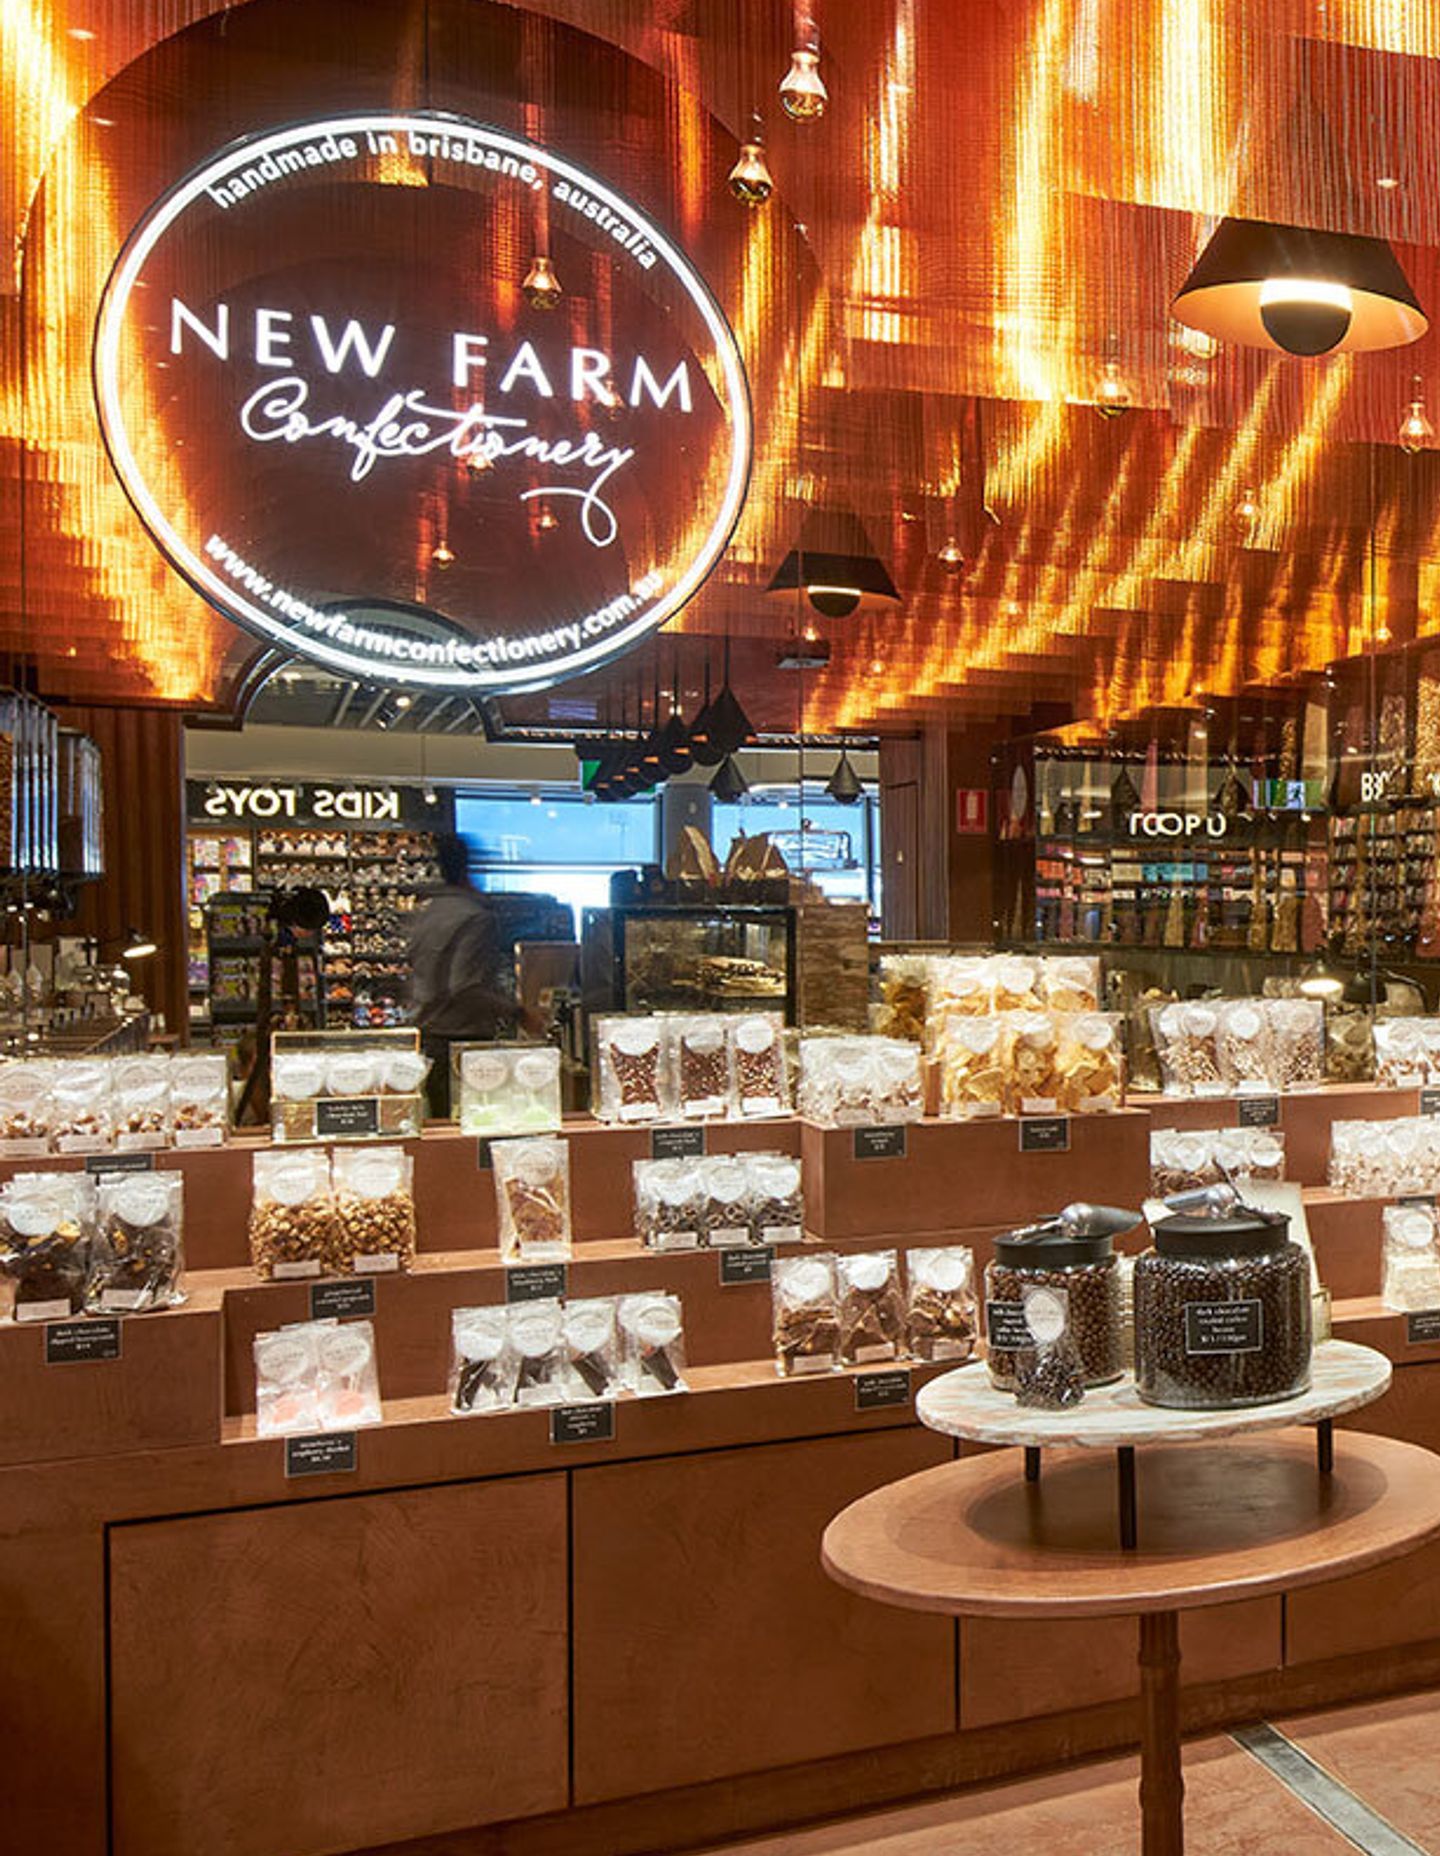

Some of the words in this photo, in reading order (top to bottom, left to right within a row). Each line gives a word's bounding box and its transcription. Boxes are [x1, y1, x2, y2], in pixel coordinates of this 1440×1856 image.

[205, 134, 359, 210] handmade
[366, 128, 398, 155] in
[408, 129, 545, 191] brisbane,
[552, 178, 658, 271] australia
[169, 297, 396, 378] NEW
[452, 332, 694, 413] FARM
[240, 377, 636, 548] Confectionery
[203, 532, 664, 667] www.newfarmconfectionery.com.au
